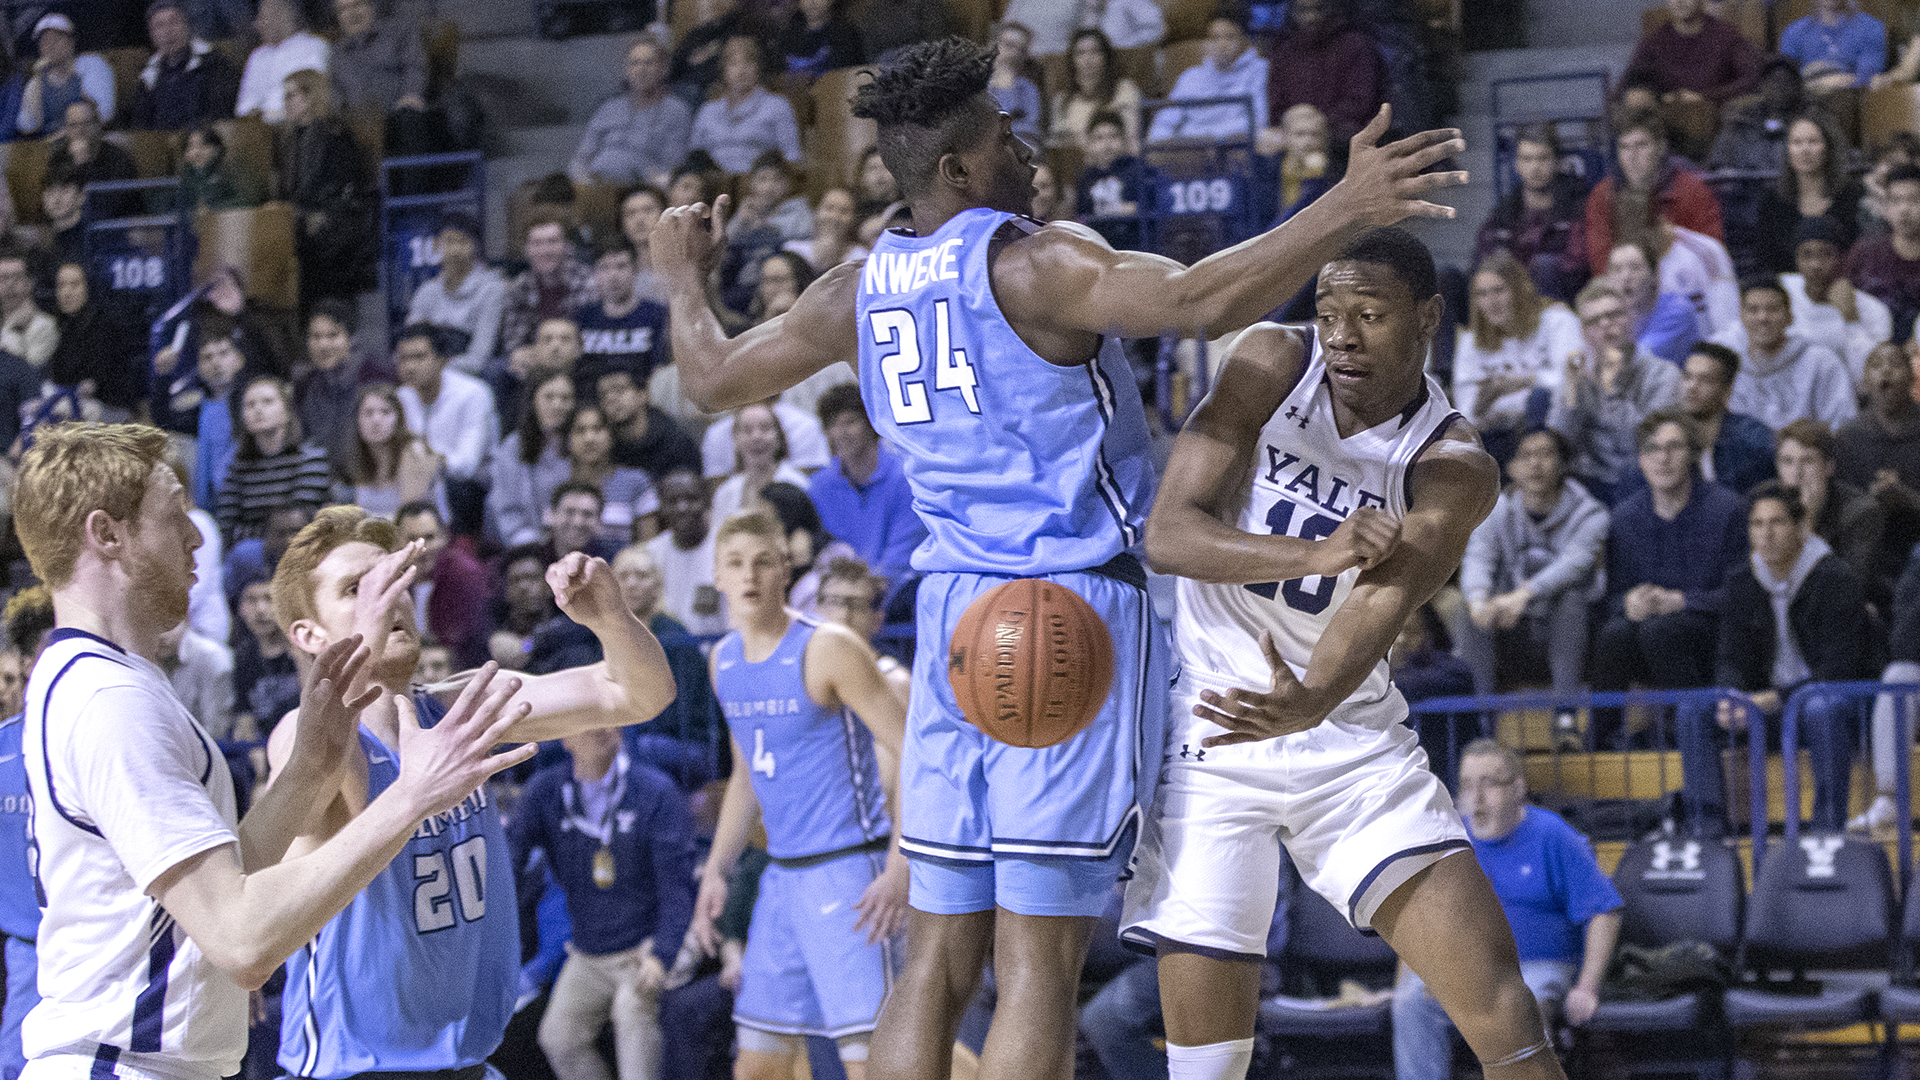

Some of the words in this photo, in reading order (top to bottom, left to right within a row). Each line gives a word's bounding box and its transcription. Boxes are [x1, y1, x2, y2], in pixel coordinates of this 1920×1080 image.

[1171, 178, 1231, 213] 109
[111, 256, 164, 289] 108
[865, 238, 963, 294] NWEKE
[868, 298, 983, 426] 24
[752, 728, 776, 778] 4
[413, 834, 487, 935] 20
